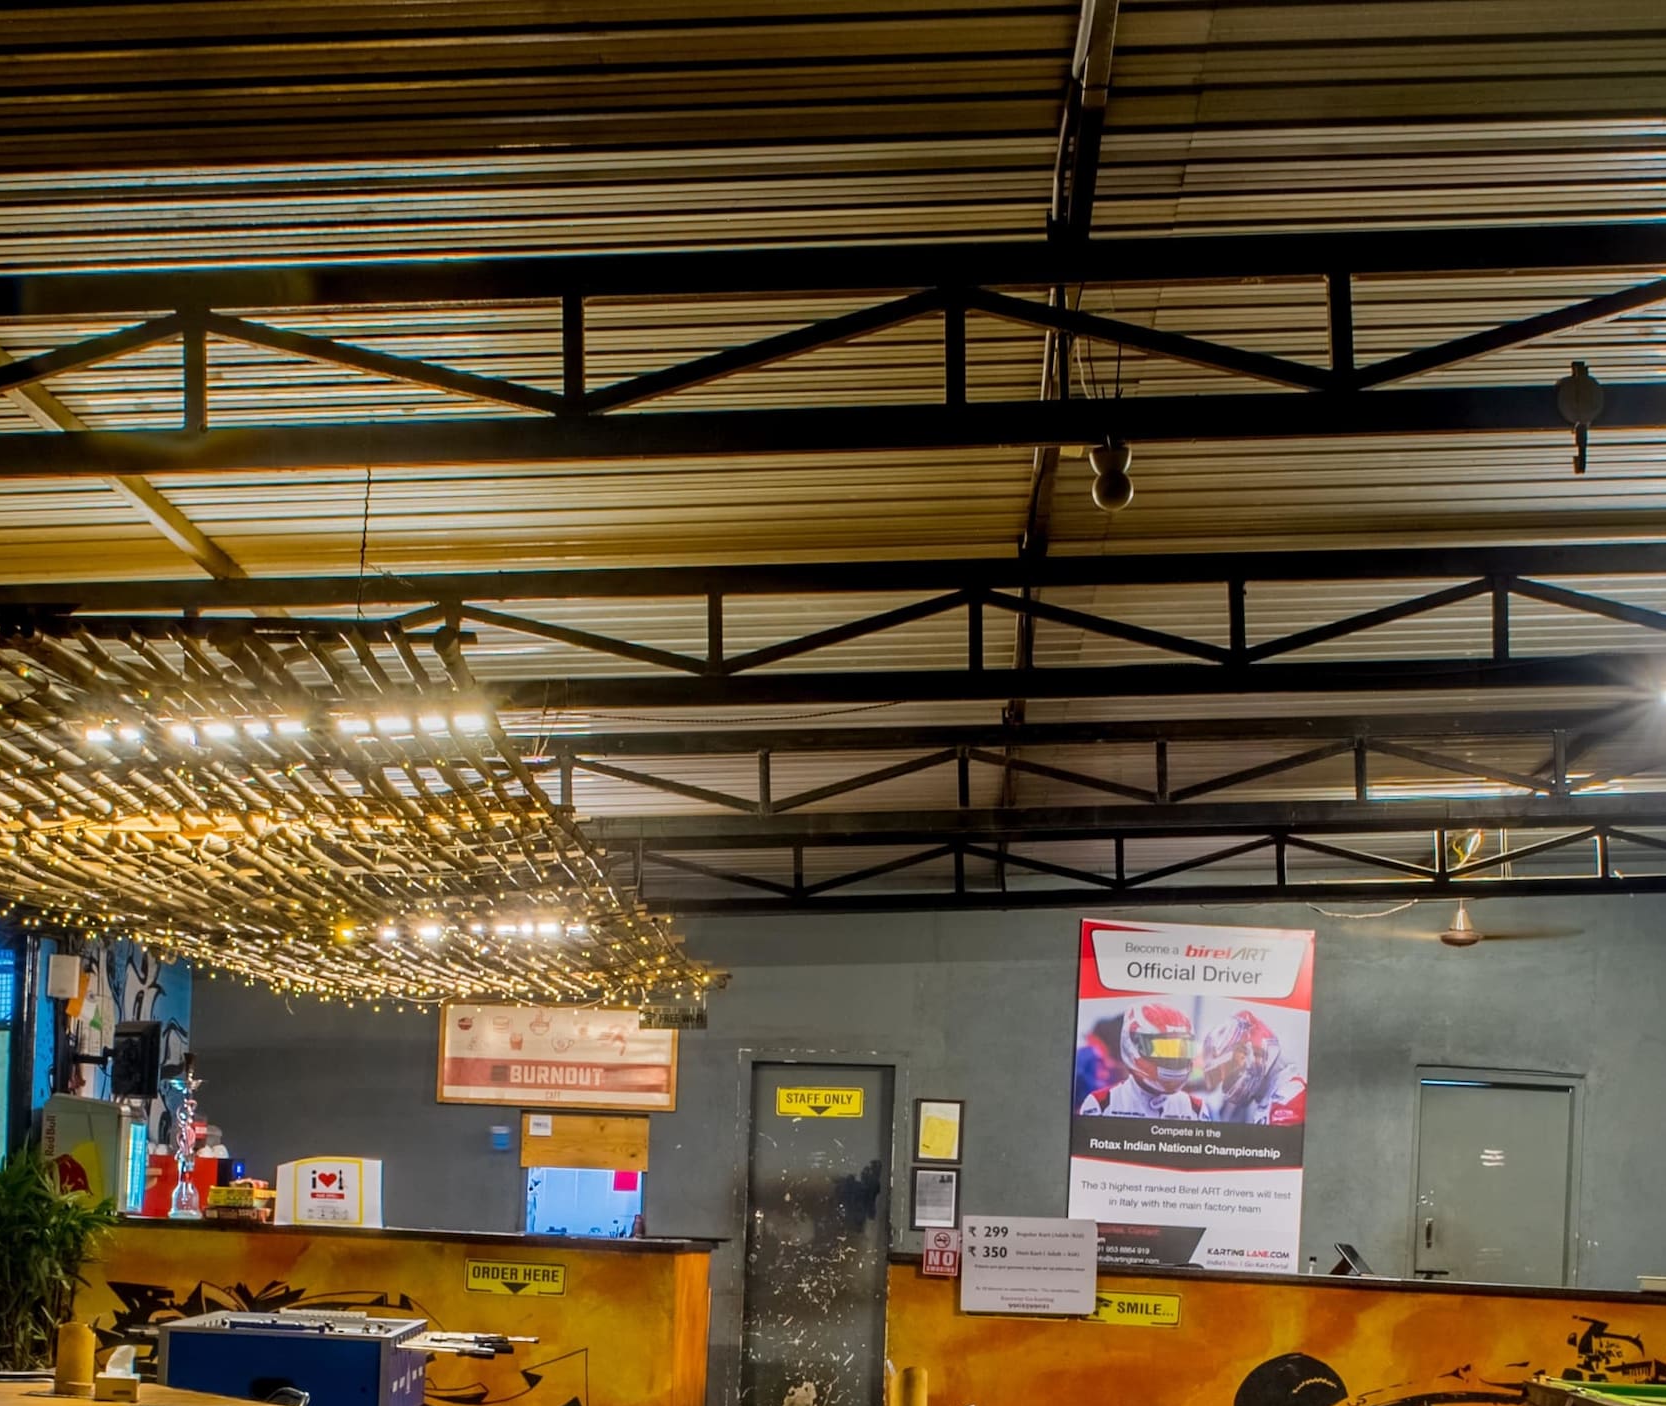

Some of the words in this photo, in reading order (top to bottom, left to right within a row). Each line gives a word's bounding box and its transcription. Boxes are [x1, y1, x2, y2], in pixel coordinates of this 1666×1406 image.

[1125, 942, 1169, 955] Become
[1172, 947, 1179, 955] a
[1127, 961, 1195, 981] Official
[1203, 965, 1262, 985] Driver
[510, 1065, 604, 1086] BURNOUT
[786, 1093, 820, 1104] STAFF
[824, 1094, 853, 1105] ONLY
[1151, 1125, 1193, 1138] Compete
[1195, 1128, 1204, 1137] in
[1206, 1129, 1221, 1138] the
[1090, 1139, 1121, 1150] Rotax
[1123, 1140, 1156, 1152] Indian
[1159, 1142, 1202, 1154] National
[1205, 1144, 1281, 1159] Championship
[1082, 1181, 1098, 1190] The
[1100, 1182, 1107, 1191] 3
[1109, 1182, 1142, 1193] highest
[1145, 1184, 1176, 1194] ranked
[1179, 1185, 1199, 1195] Birel
[1201, 1186, 1221, 1196] ART
[1223, 1188, 1254, 1198] drivers
[1257, 1190, 1272, 1199] will
[1274, 1191, 1291, 1200] test
[1108, 1198, 1116, 1206] in
[1119, 1199, 1138, 1209] Italy
[1141, 1199, 1160, 1208] with
[1162, 1200, 1177, 1209] the
[1179, 1202, 1202, 1211] main
[1204, 1202, 1236, 1214] factory
[1238, 1205, 1261, 1214] team
[984, 1226, 1008, 1238] 299
[928, 1251, 955, 1266] NO
[983, 1246, 1007, 1258] 350
[1207, 1248, 1244, 1257] KARTING
[472, 1265, 518, 1280] ORDER
[523, 1268, 559, 1282] HERE
